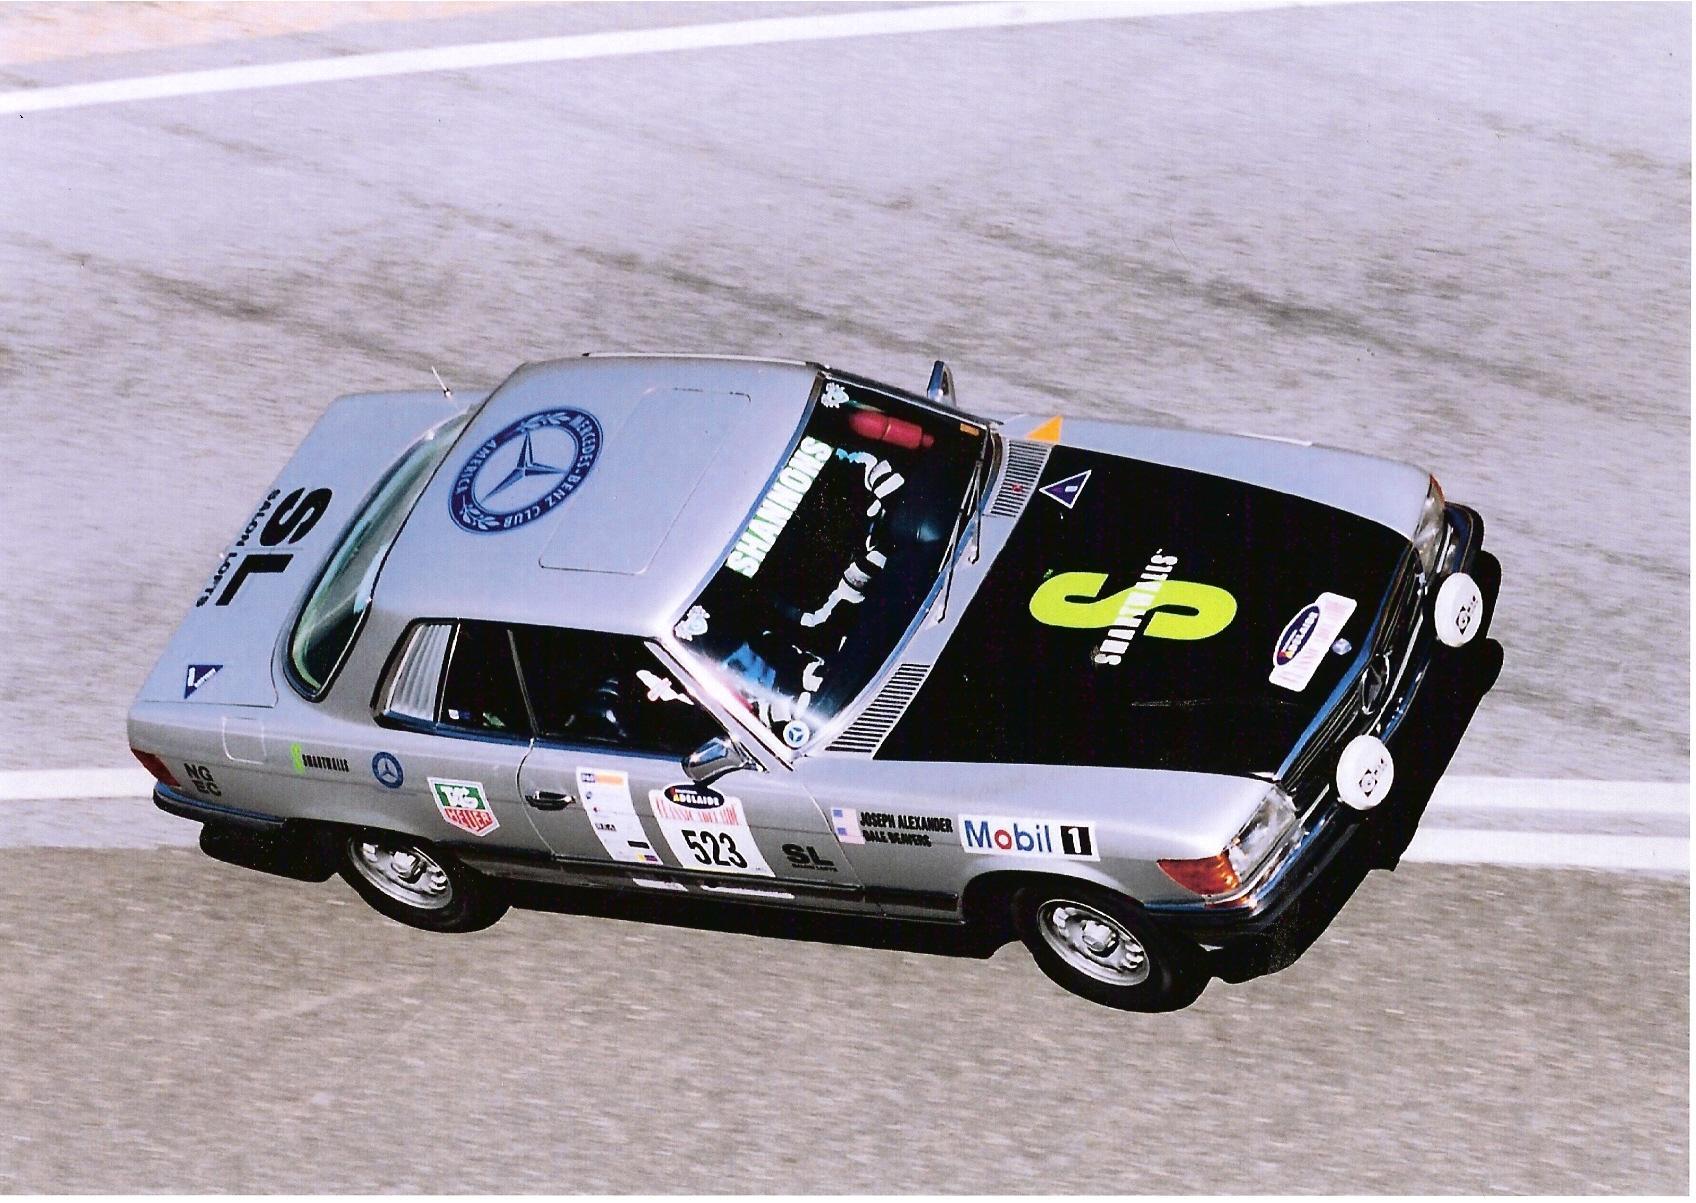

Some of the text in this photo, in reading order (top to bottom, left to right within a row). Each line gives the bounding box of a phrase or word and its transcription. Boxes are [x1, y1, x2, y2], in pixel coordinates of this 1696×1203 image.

[456, 439, 497, 494] AMERICA
[503, 505, 541, 528] CLUB
[726, 436, 834, 579] SHANNONS
[216, 487, 333, 606] SL
[183, 763, 214, 782] NG
[192, 779, 221, 796] EC
[859, 812, 953, 832] JOSEPH ALEXANDER
[964, 819, 1081, 854] Mobil 1
[681, 829, 748, 869] 523
[782, 843, 834, 866] SL
